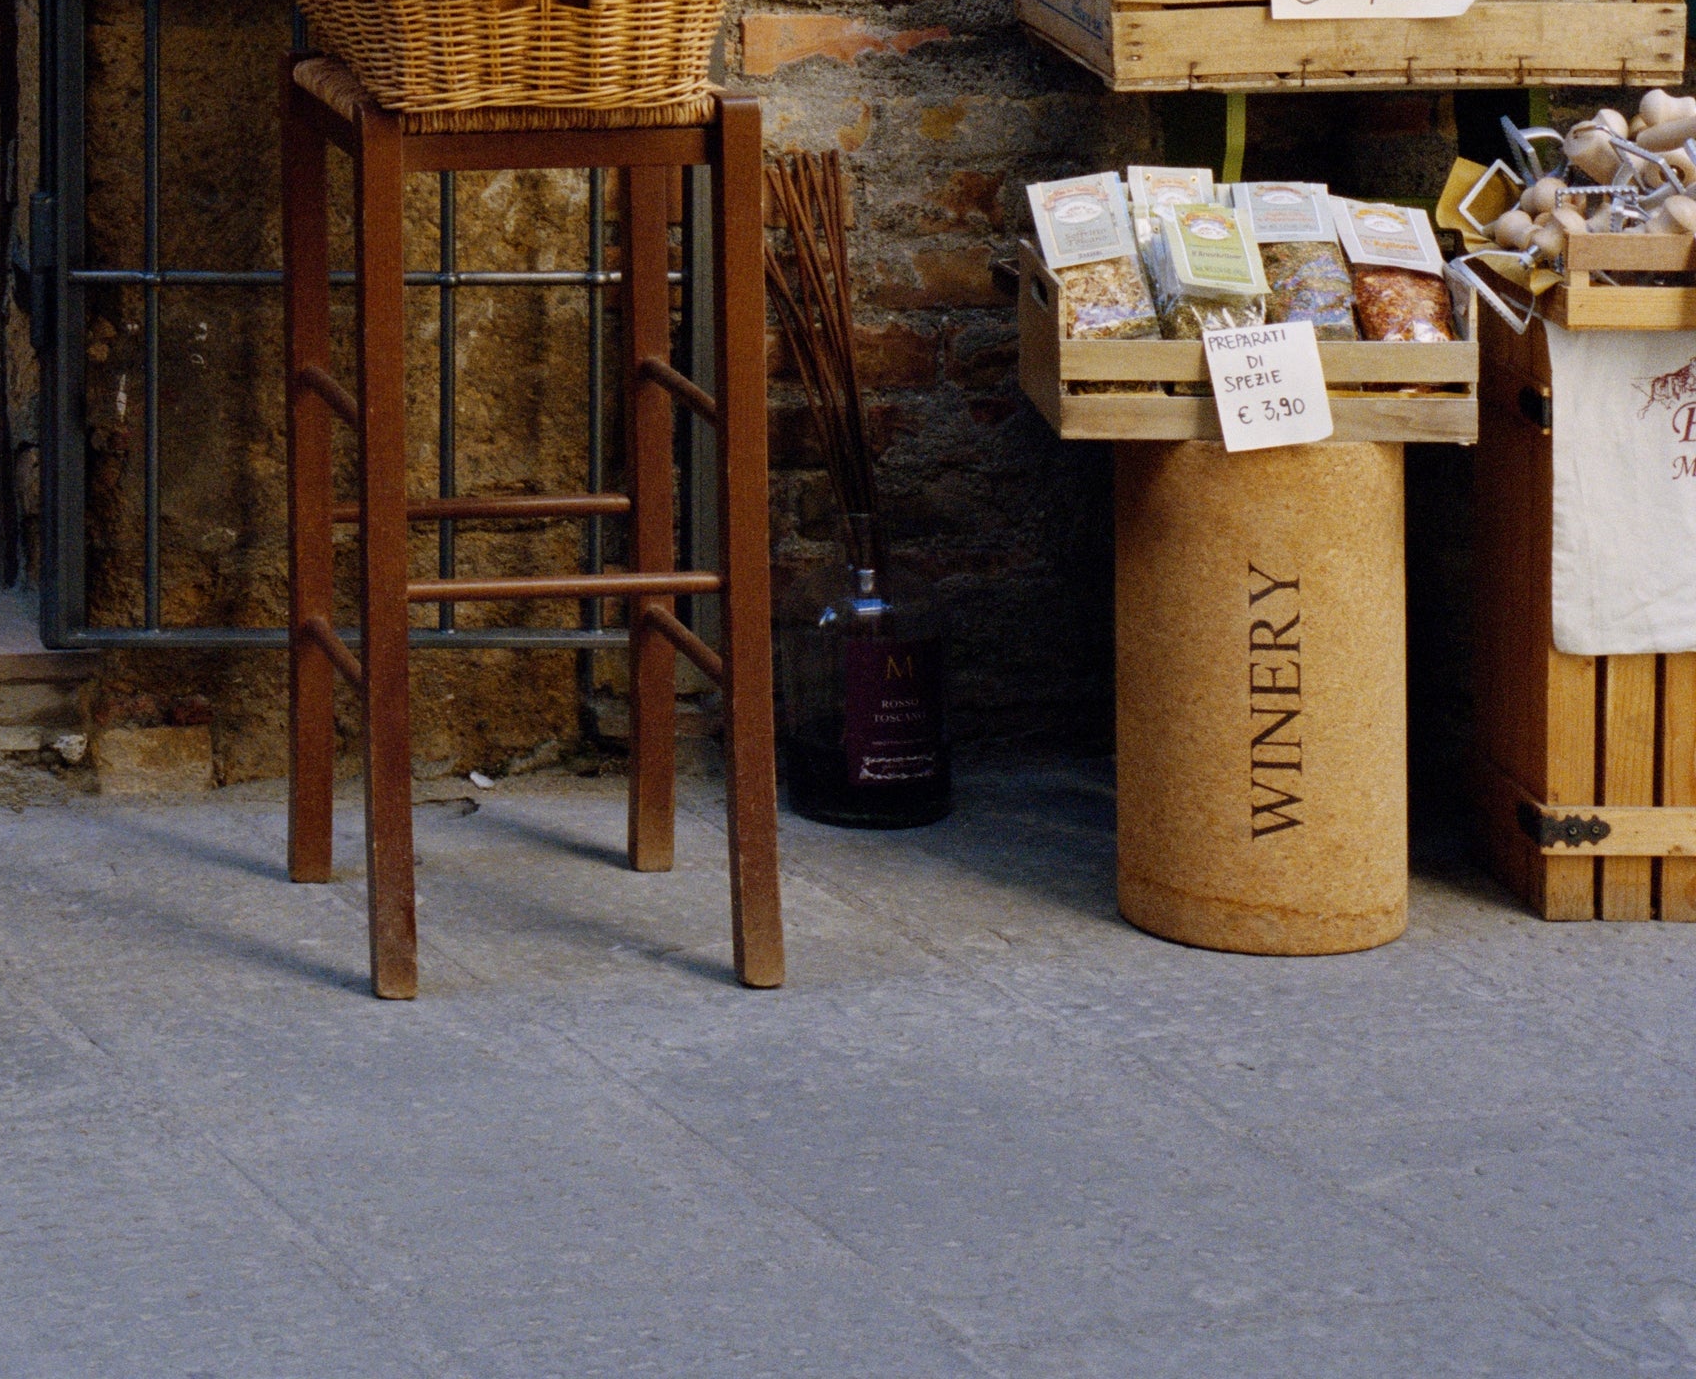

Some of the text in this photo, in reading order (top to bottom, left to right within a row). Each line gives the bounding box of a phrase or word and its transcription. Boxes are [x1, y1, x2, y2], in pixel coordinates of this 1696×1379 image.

[1208, 329, 1286, 352] PREPARATI
[1246, 355, 1263, 369] DI
[1224, 370, 1282, 393] SPEZIE
[1238, 397, 1305, 424] € 3,90
[881, 697, 919, 708] ROSSO
[1247, 560, 1305, 842] WINERY
